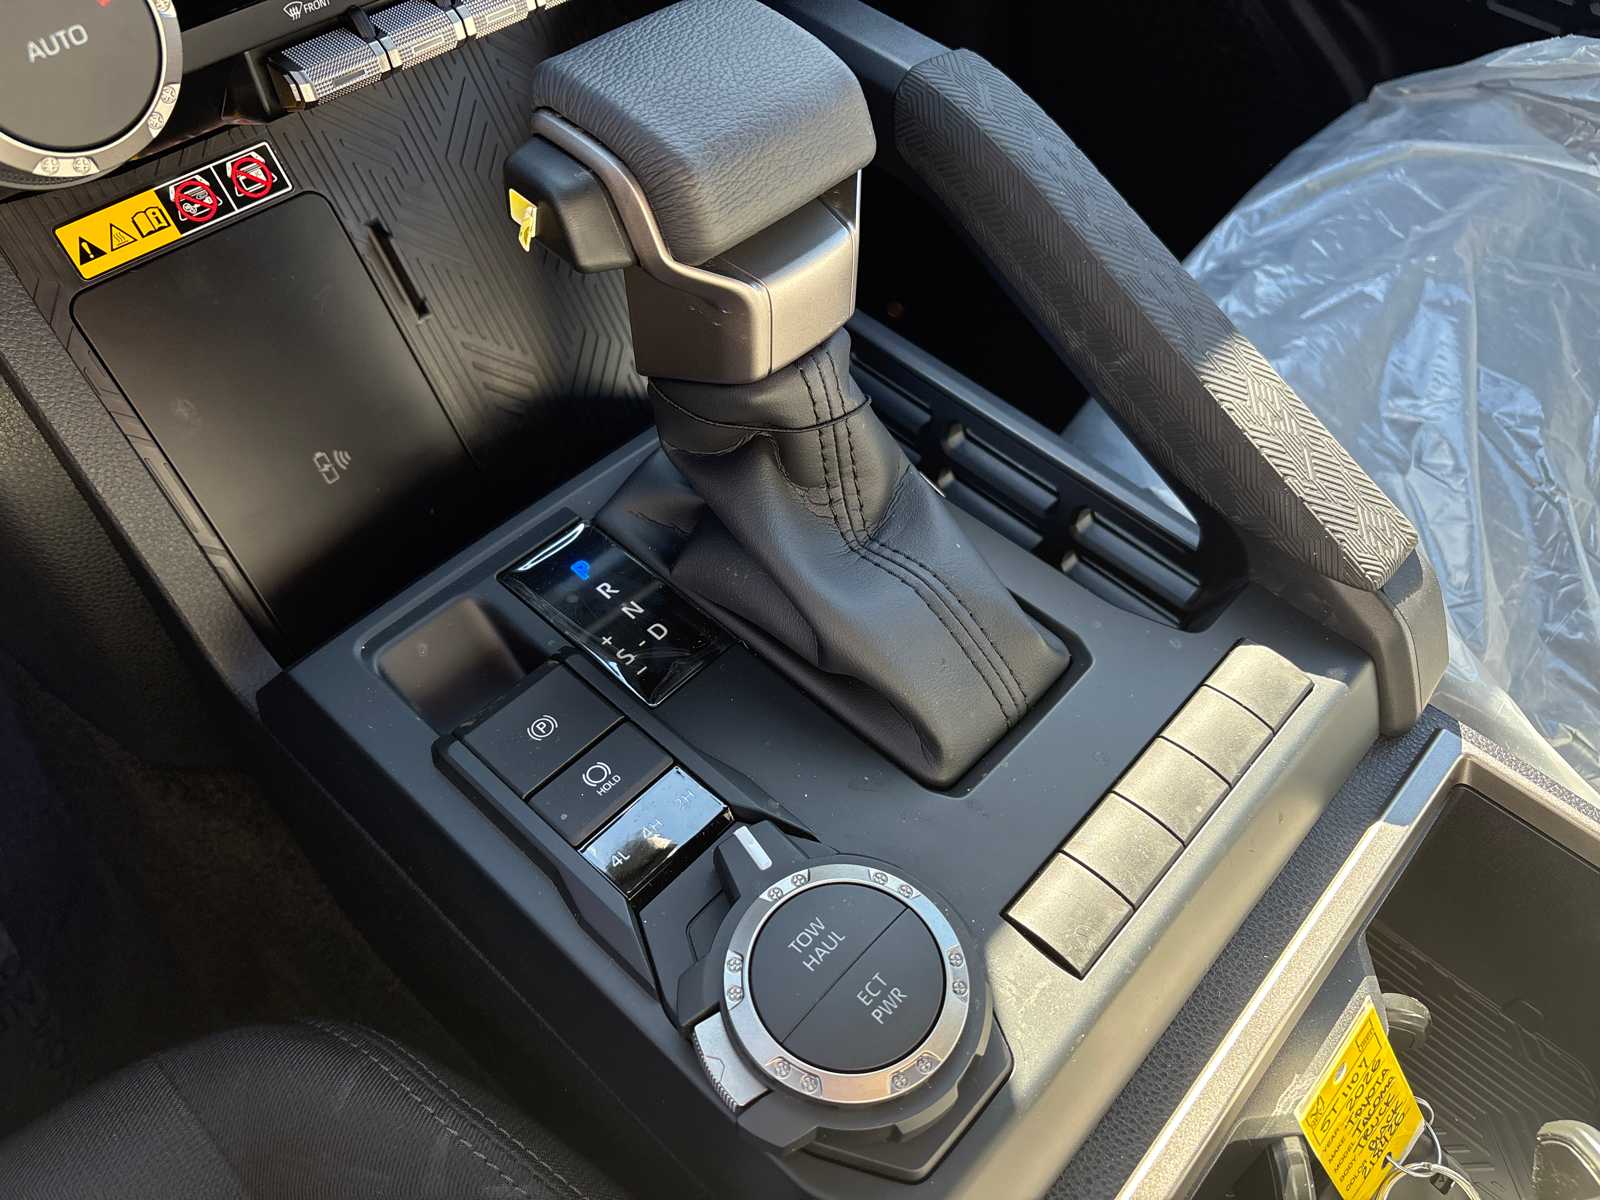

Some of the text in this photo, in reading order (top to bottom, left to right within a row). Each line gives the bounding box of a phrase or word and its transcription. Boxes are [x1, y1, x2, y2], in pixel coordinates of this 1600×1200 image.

[27, 24, 89, 63] AUTO
[570, 560, 590, 580] P
[596, 582, 620, 600] R
[621, 600, 645, 620] N
[646, 623, 668, 641] D
[616, 648, 636, 666] S
[596, 774, 621, 796] HOLD
[674, 788, 696, 810] 2H
[642, 818, 664, 839] 4H
[611, 850, 631, 867] 4L
[788, 917, 826, 953] TOW
[802, 931, 846, 972] HAUL
[856, 972, 887, 1006] ECT
[871, 987, 908, 1025] PWR
[1323, 1058, 1381, 1152] YEAR 2026
[1328, 1069, 1390, 1164] MAKE TOYOTA
[1339, 1093, 1396, 1182] BODY TRUCK
[1333, 1141, 1355, 1173] MODEL
[1345, 1159, 1367, 1192] COLOR
